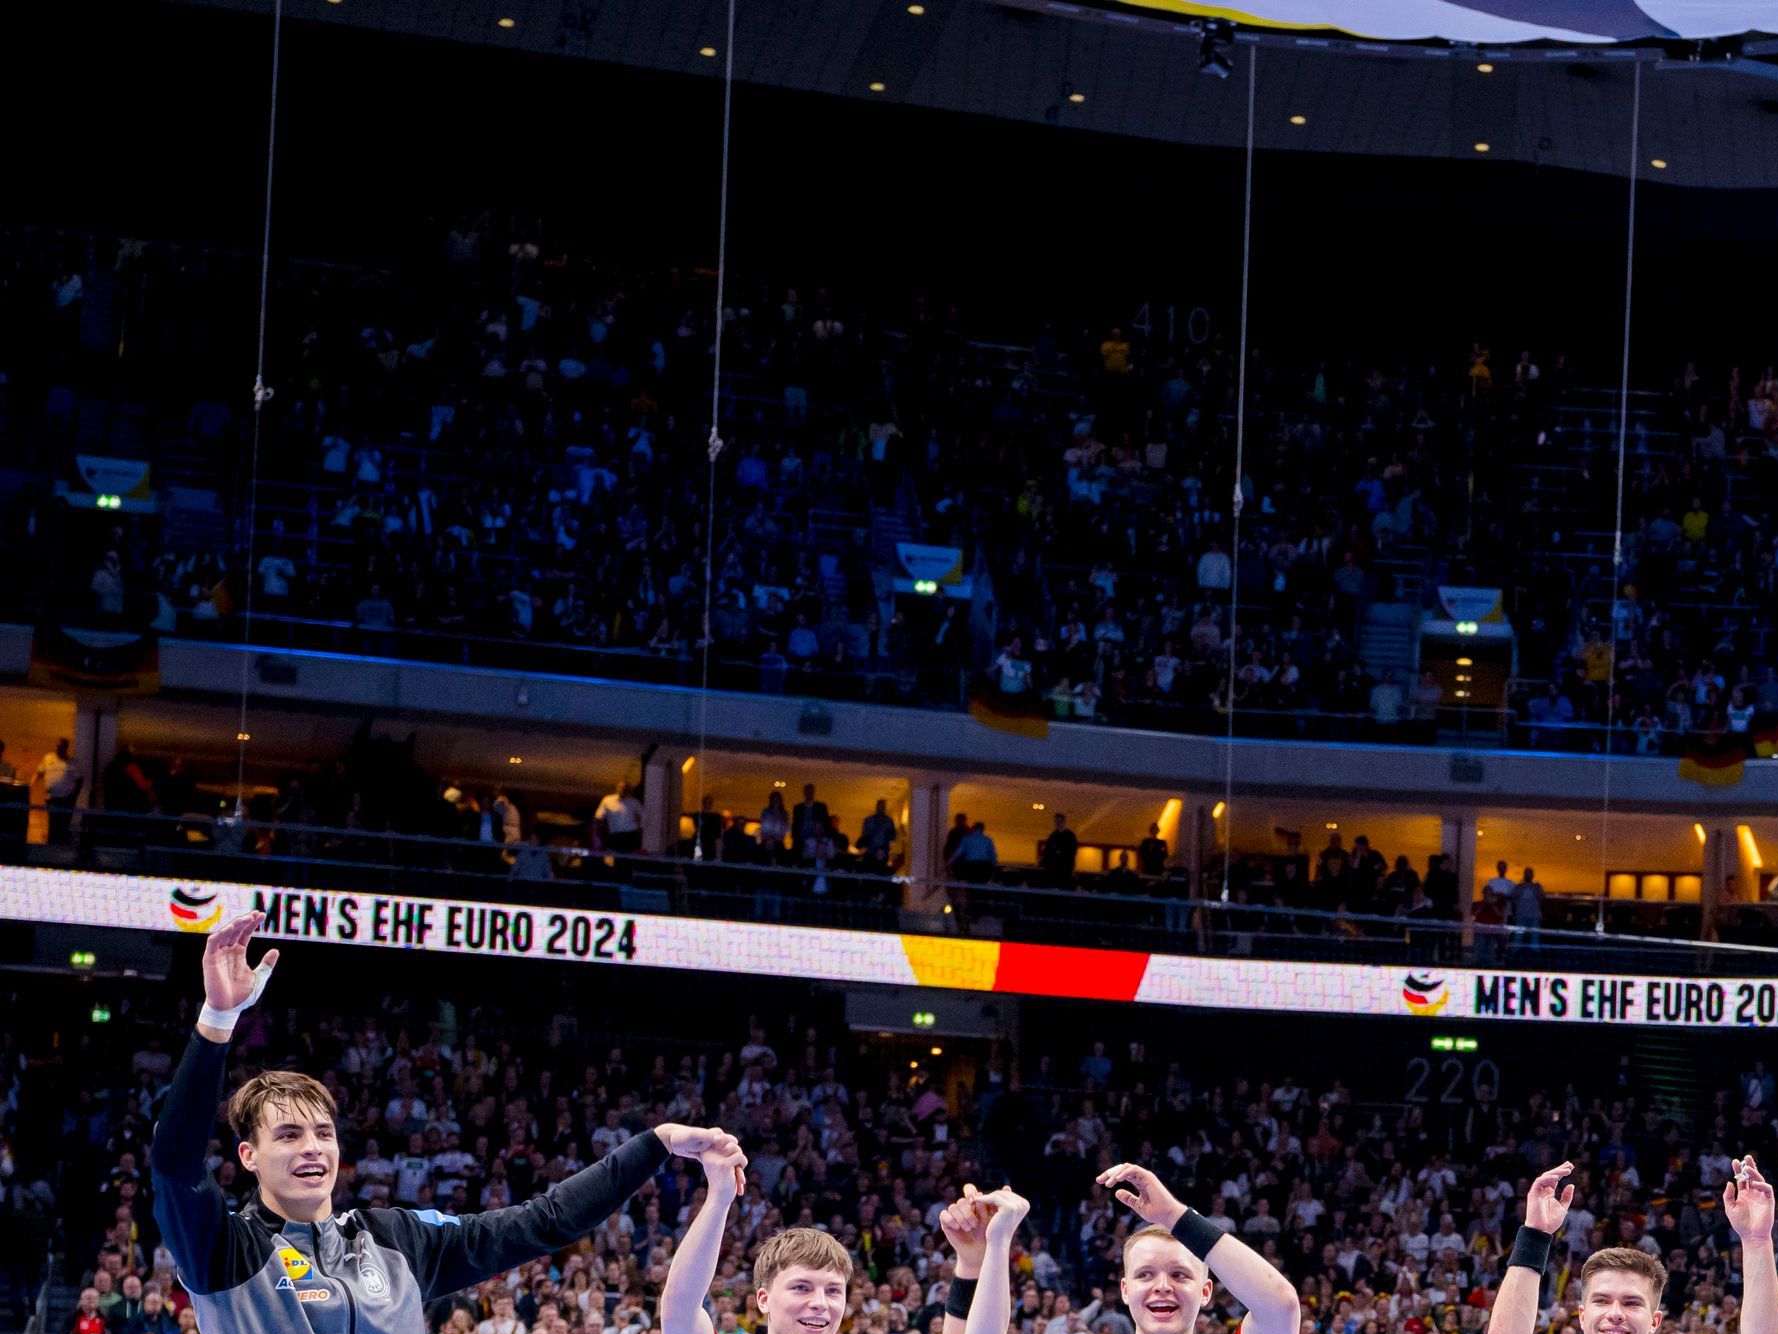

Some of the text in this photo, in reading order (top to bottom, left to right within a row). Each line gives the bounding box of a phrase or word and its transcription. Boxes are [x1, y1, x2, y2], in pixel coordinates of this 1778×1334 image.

[255, 890, 637, 960] MEN'S EHF EURO 2024
[1474, 974, 1568, 1018] MEN'S
[1581, 979, 1634, 1020] EHF
[1646, 981, 1725, 1023] EURO
